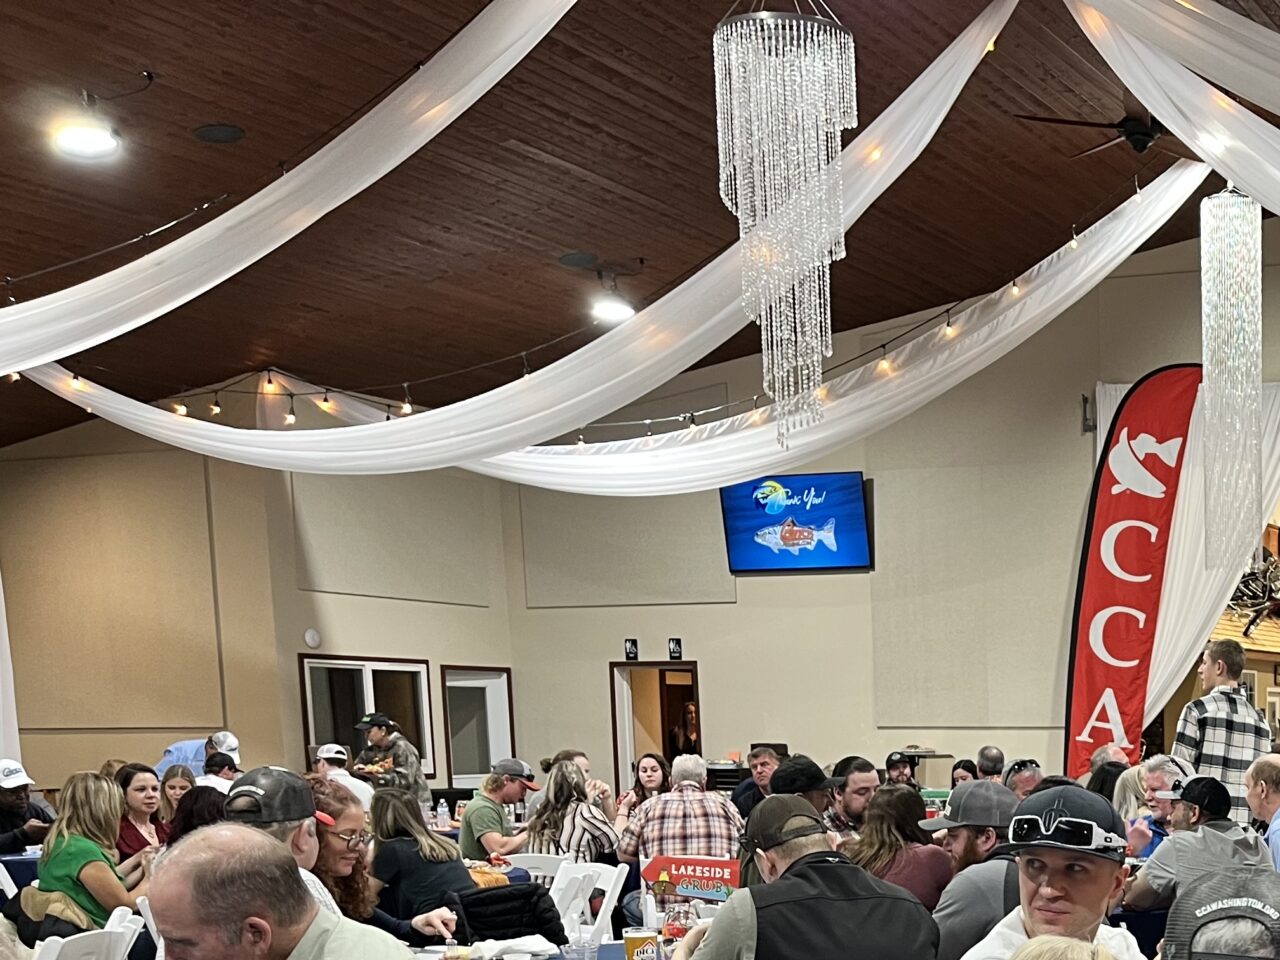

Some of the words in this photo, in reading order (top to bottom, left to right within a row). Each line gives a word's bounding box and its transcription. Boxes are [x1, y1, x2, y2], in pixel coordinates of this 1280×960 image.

[671, 864, 731, 879] LAKESIDE
[680, 878, 724, 893] GRUB
[1194, 897, 1280, 920] CCAWASHINGTON.ORG
